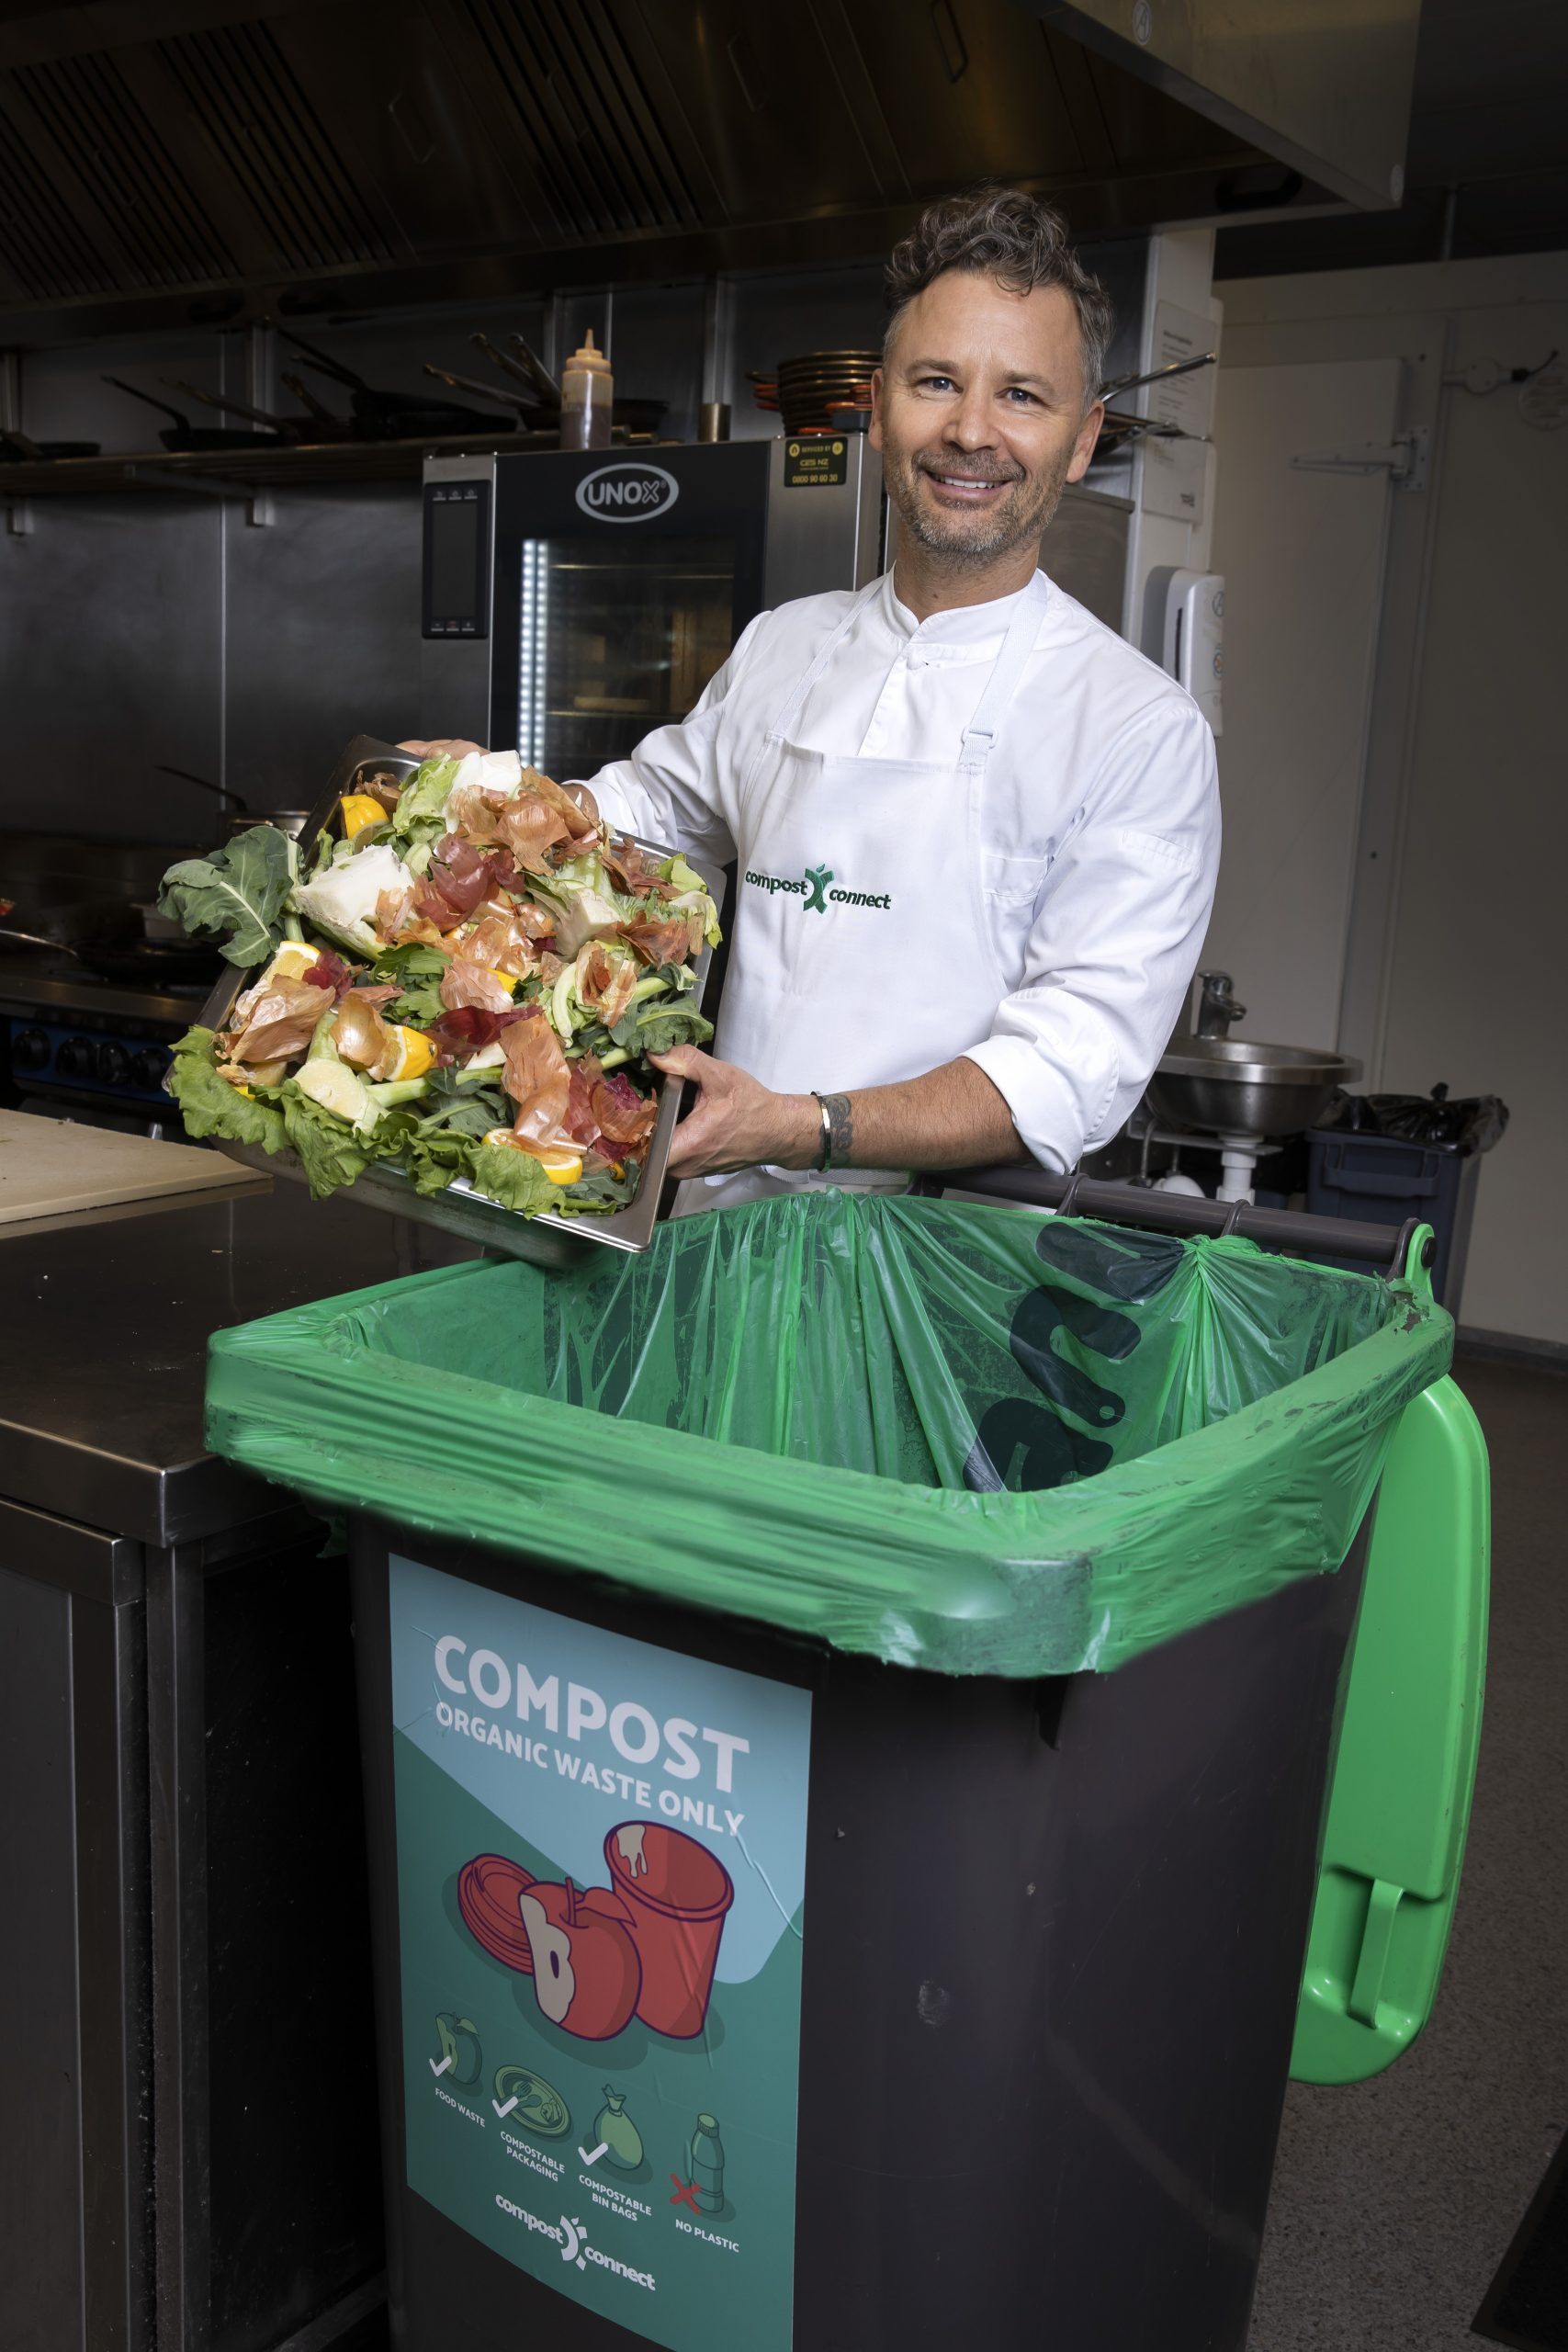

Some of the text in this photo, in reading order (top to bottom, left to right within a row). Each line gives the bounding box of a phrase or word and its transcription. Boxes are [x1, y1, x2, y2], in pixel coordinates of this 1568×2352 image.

[588, 480, 660, 506] UNOX
[792, 473, 838, 484] 0800 90 60 30
[745, 870, 892, 910] compost connect
[434, 1634, 750, 1794] COMPOST
[434, 1702, 746, 1838] ORGANIC WASTE ONLY
[434, 2086, 486, 2128] FOOD WASTE
[500, 2131, 566, 2175] COMPOSTABLE
[506, 2146, 558, 2182] PACKAGING
[578, 2174, 652, 2216] COMPOSTABLE
[592, 2192, 638, 2222] BIN BAGS
[495, 2194, 656, 2291] compost connect
[675, 2218, 740, 2253] NO PLASTIC
